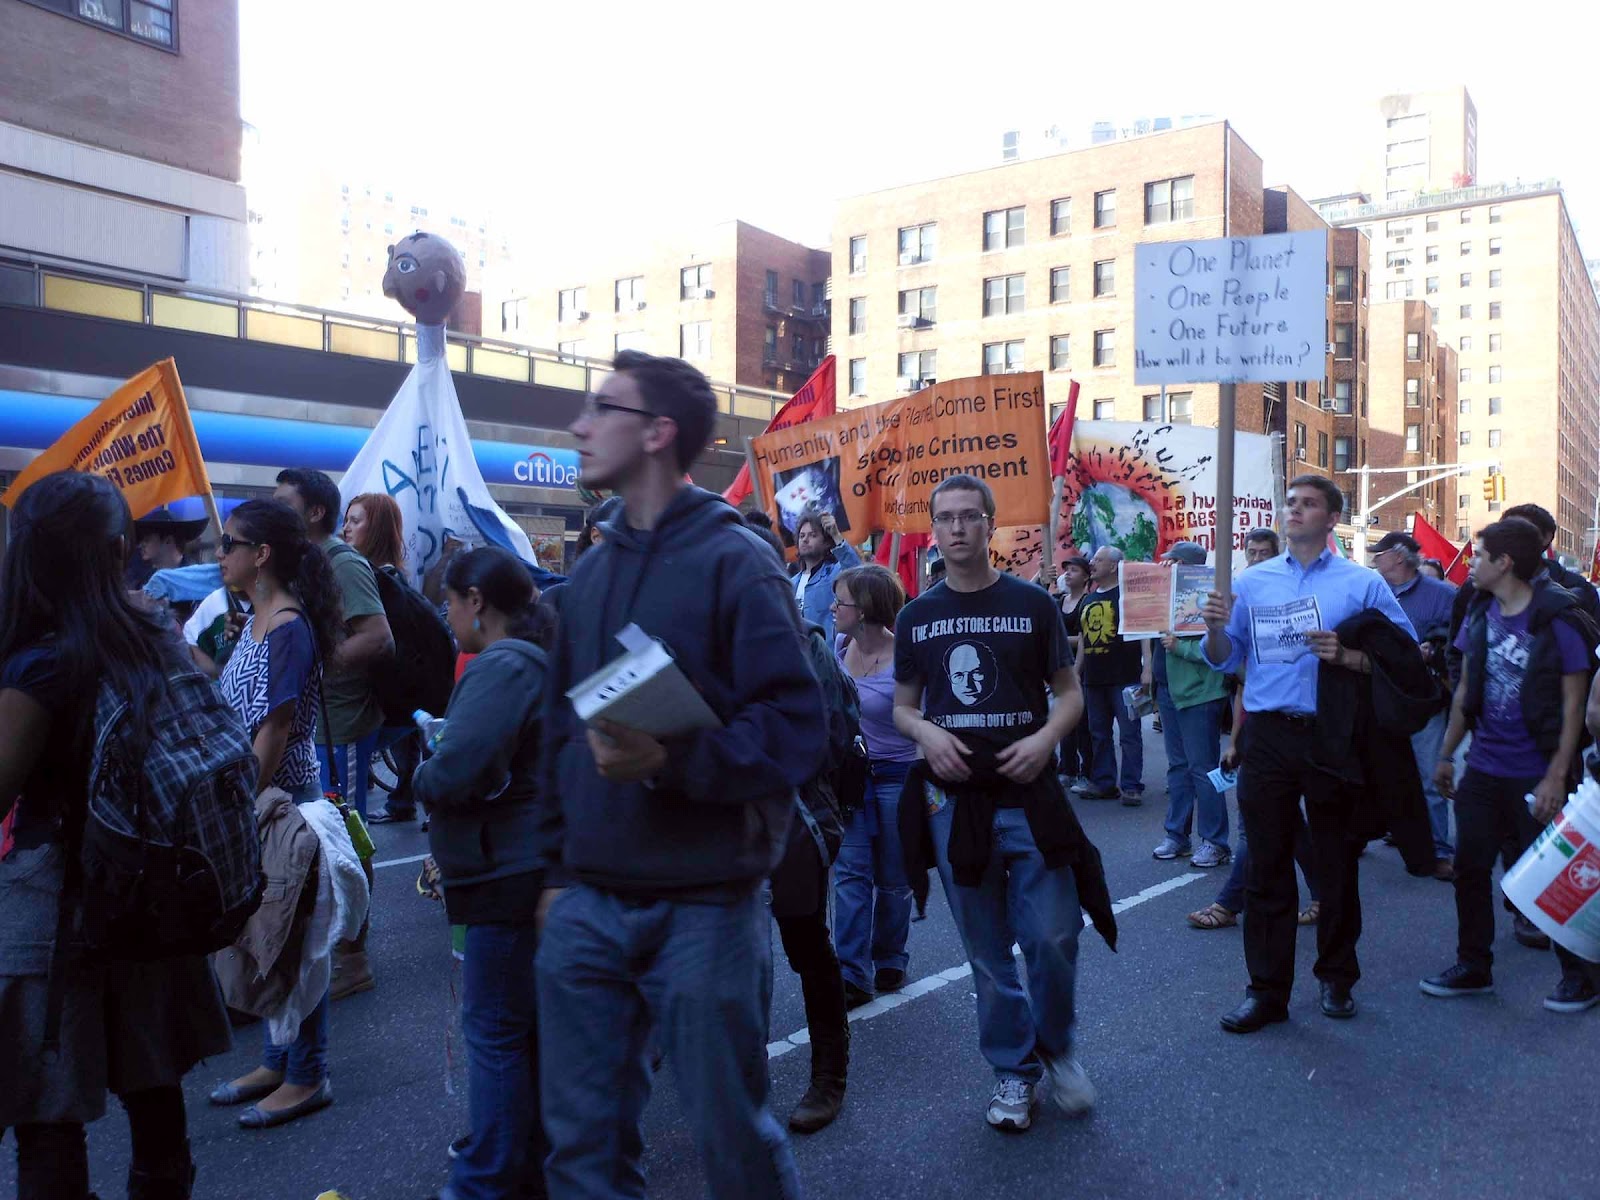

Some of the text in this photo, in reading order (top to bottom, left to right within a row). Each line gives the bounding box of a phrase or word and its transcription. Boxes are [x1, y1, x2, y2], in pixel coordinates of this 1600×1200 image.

[1168, 238, 1296, 277] One Planet
[1167, 275, 1288, 316] One People
[1169, 313, 1288, 341] One Future
[1135, 349, 1160, 368] How
[1167, 347, 1190, 367] will
[1196, 348, 1204, 366] it
[1216, 346, 1231, 366] be
[753, 431, 834, 467] Humanity
[839, 419, 871, 446] and
[935, 394, 986, 418] Come
[928, 433, 1018, 457] Crimes
[513, 458, 583, 486] citiba
[852, 474, 873, 497] of
[906, 456, 1029, 488] overnment
[1162, 490, 1274, 512] La huanidad
[1162, 510, 1274, 533] necesa la
[912, 616, 1032, 643] THE JERK STORE CALLED
[946, 713, 986, 729] RUNNING
[987, 713, 1006, 728] OUT
